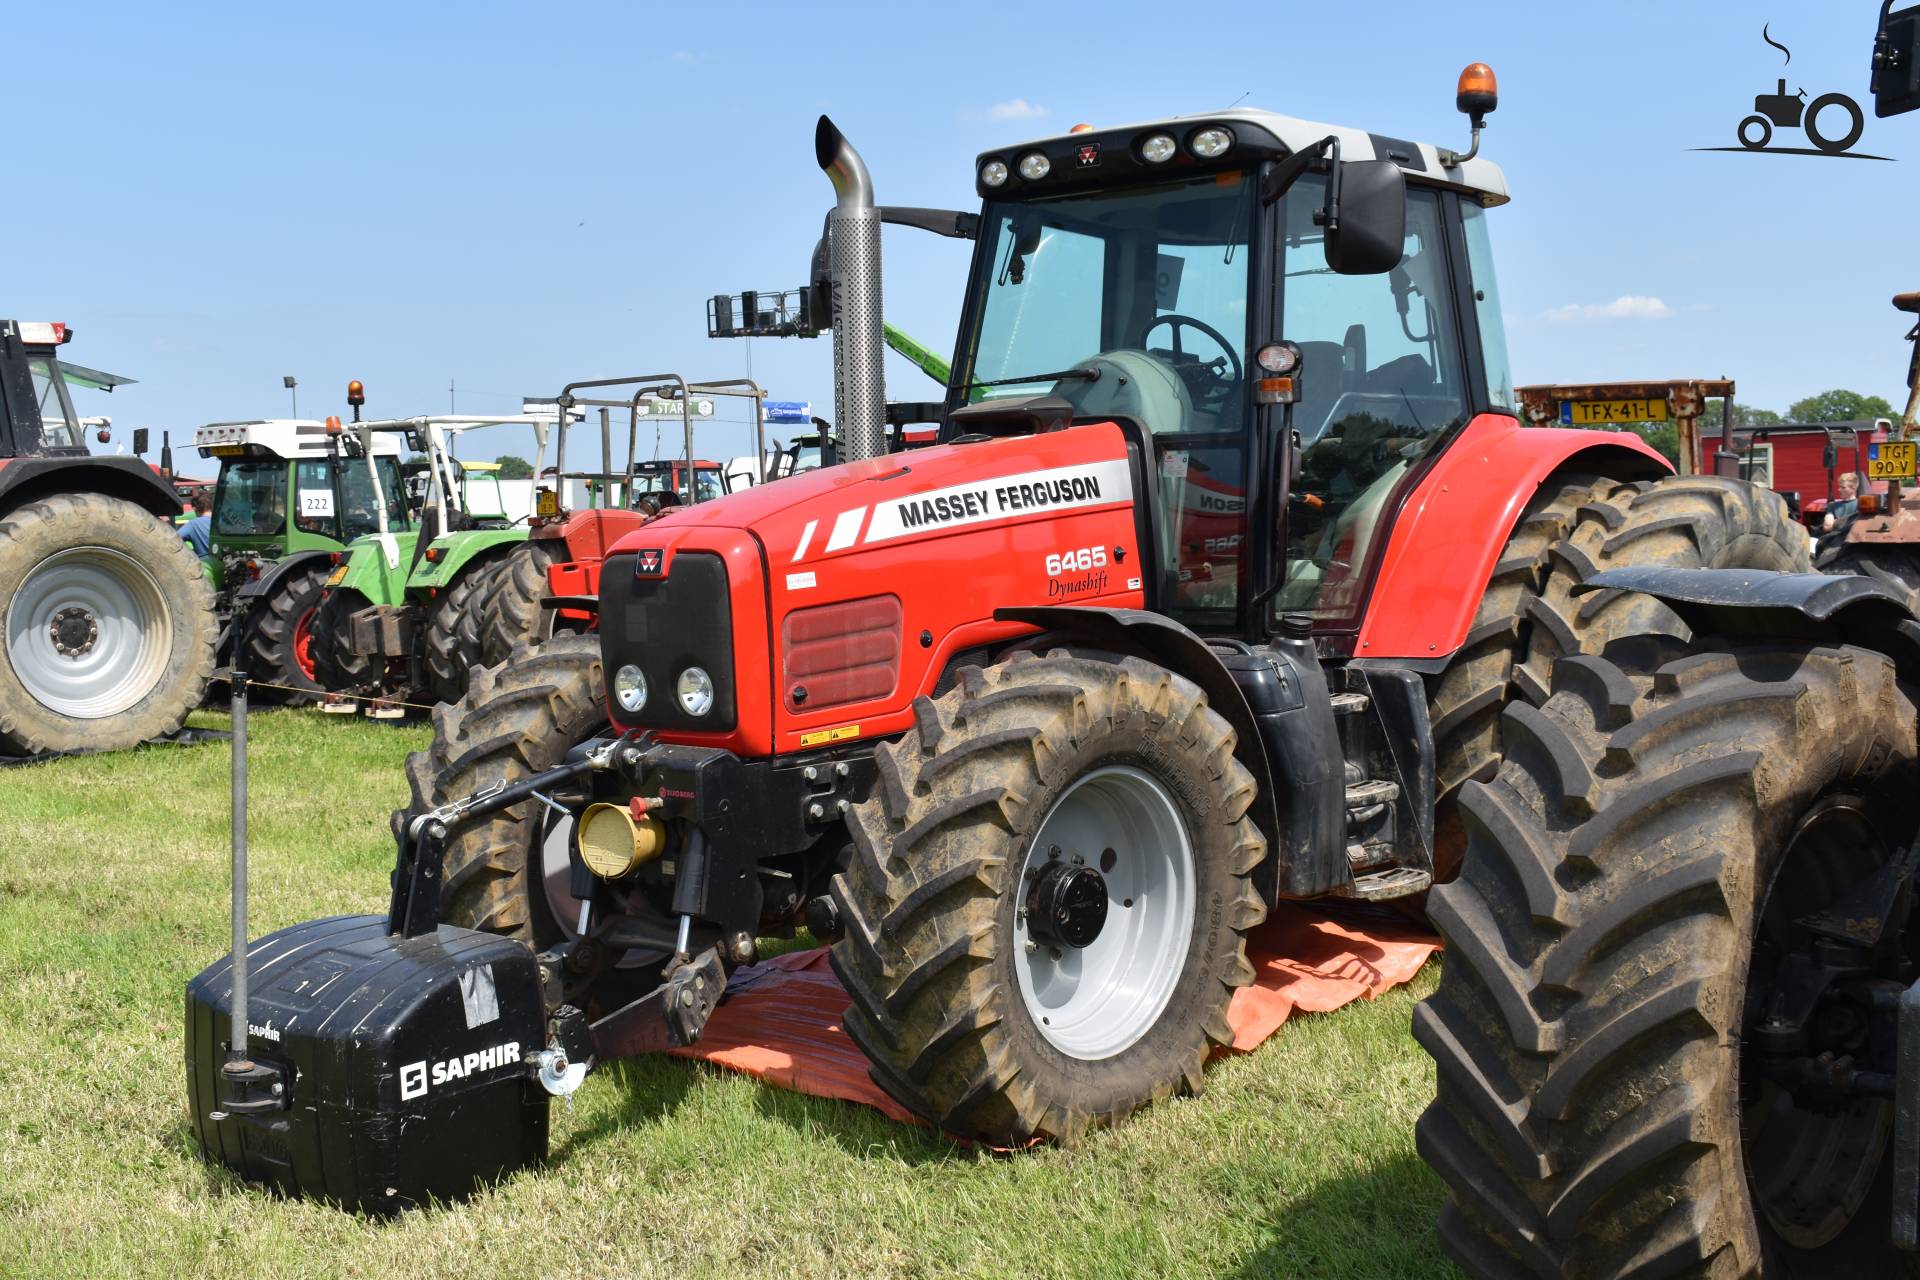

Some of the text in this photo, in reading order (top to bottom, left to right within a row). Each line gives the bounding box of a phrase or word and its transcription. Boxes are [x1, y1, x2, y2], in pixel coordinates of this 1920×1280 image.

[658, 402, 692, 414] STAR
[1581, 401, 1657, 420] TFX-41-L
[1883, 445, 1910, 459] TGF
[1876, 461, 1908, 474] 90-V
[306, 498, 328, 510] 222
[898, 475, 1101, 528] MASSEY FERGUSON
[1045, 545, 1108, 577] 6465
[1048, 570, 1108, 601] Dynashift
[248, 1024, 281, 1042] SAPHIR
[431, 1041, 521, 1086] SAPHIR
